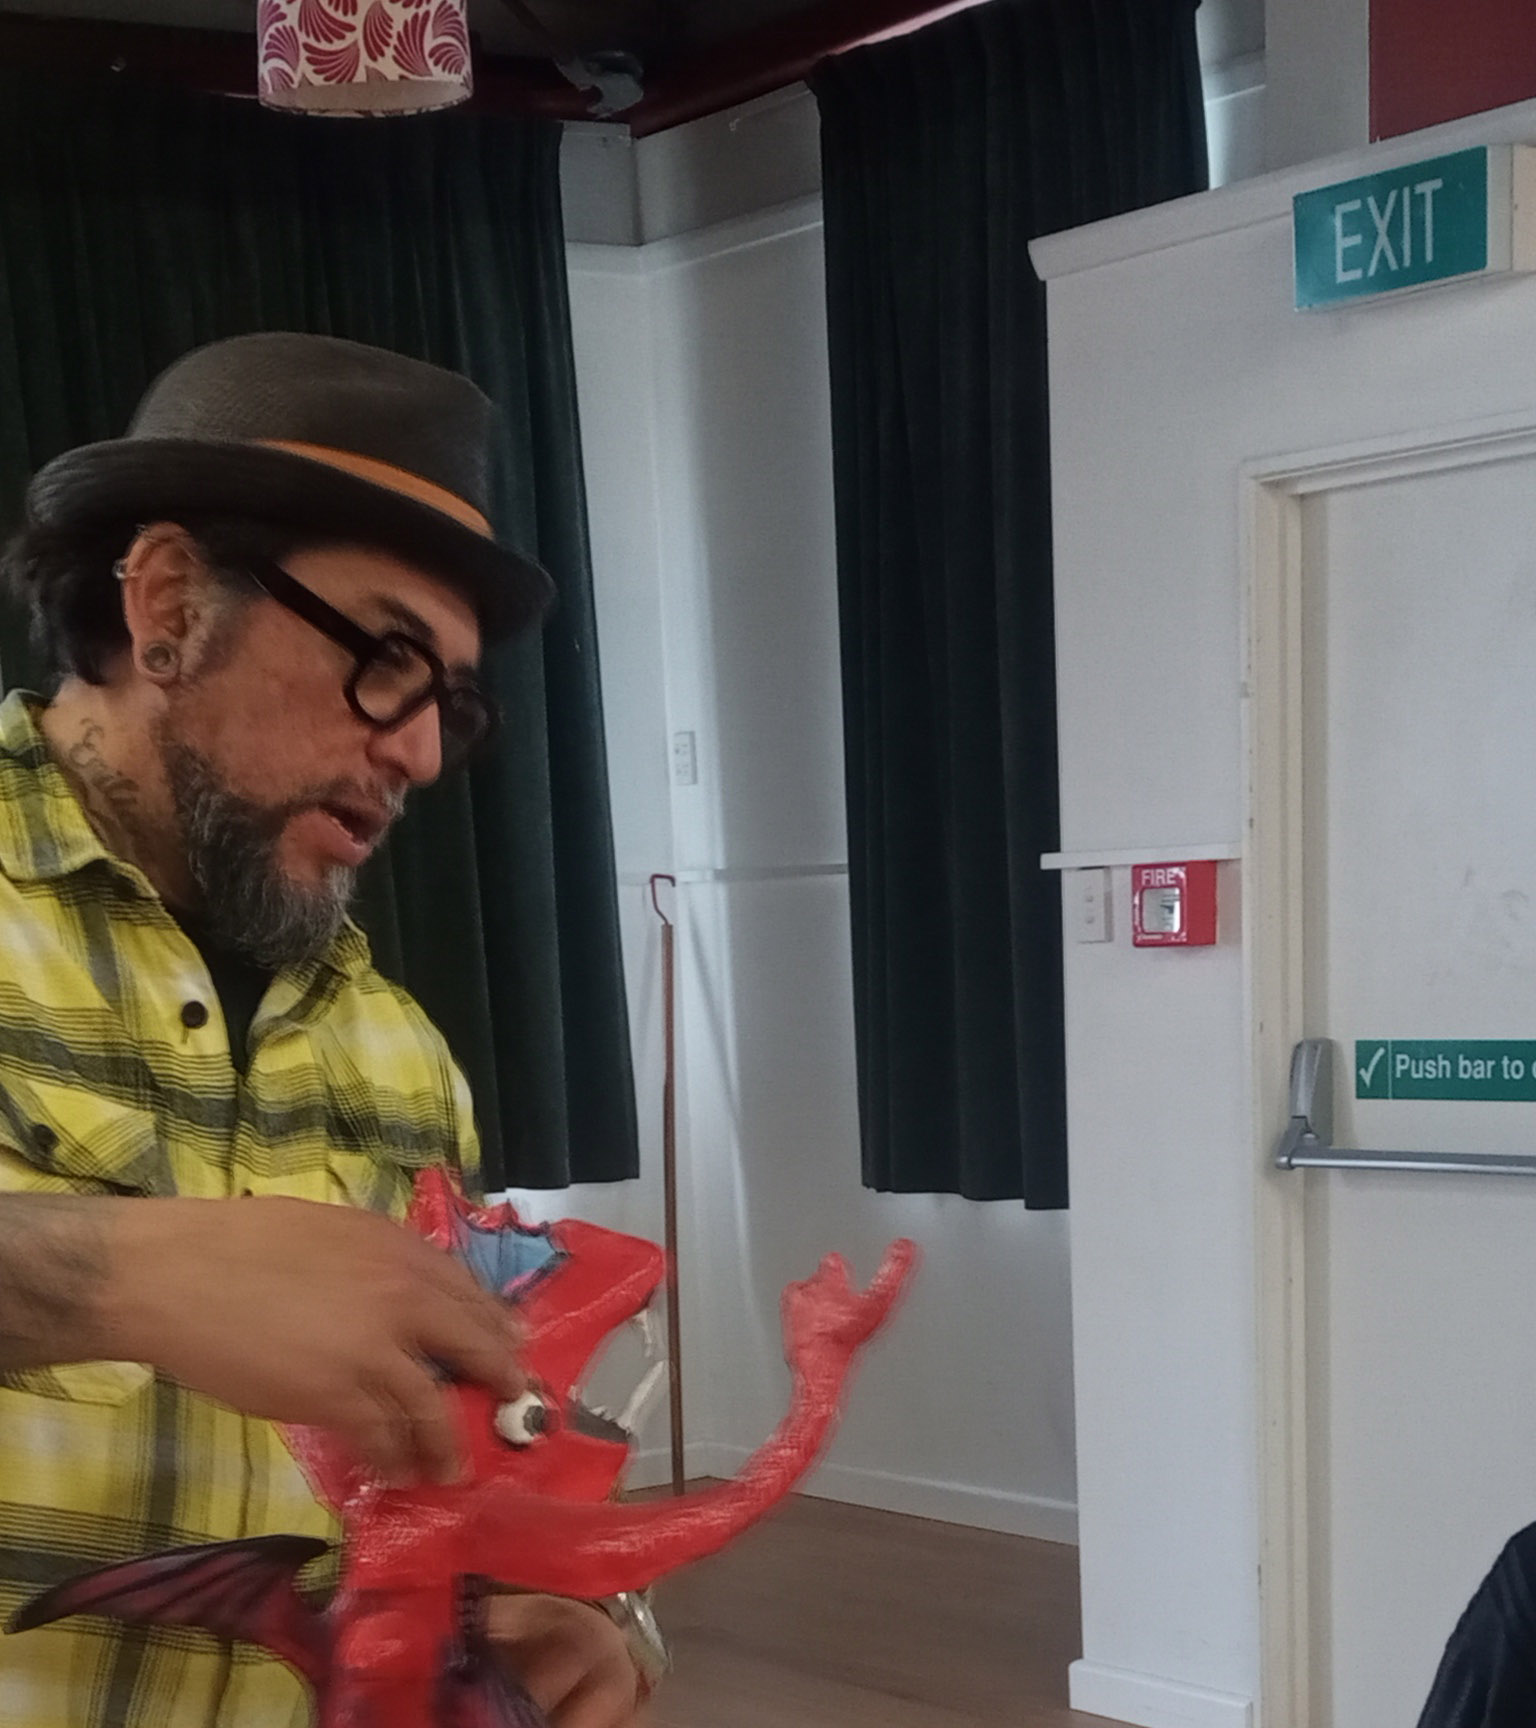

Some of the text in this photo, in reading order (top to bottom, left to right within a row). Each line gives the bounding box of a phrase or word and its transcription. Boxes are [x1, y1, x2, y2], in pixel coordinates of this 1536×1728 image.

[1335, 178, 1443, 284] EXIT
[1141, 868, 1177, 886] FIRE
[1395, 1054, 1451, 1080] Push
[1458, 1054, 1496, 1080] bar
[1502, 1055, 1525, 1080] to
